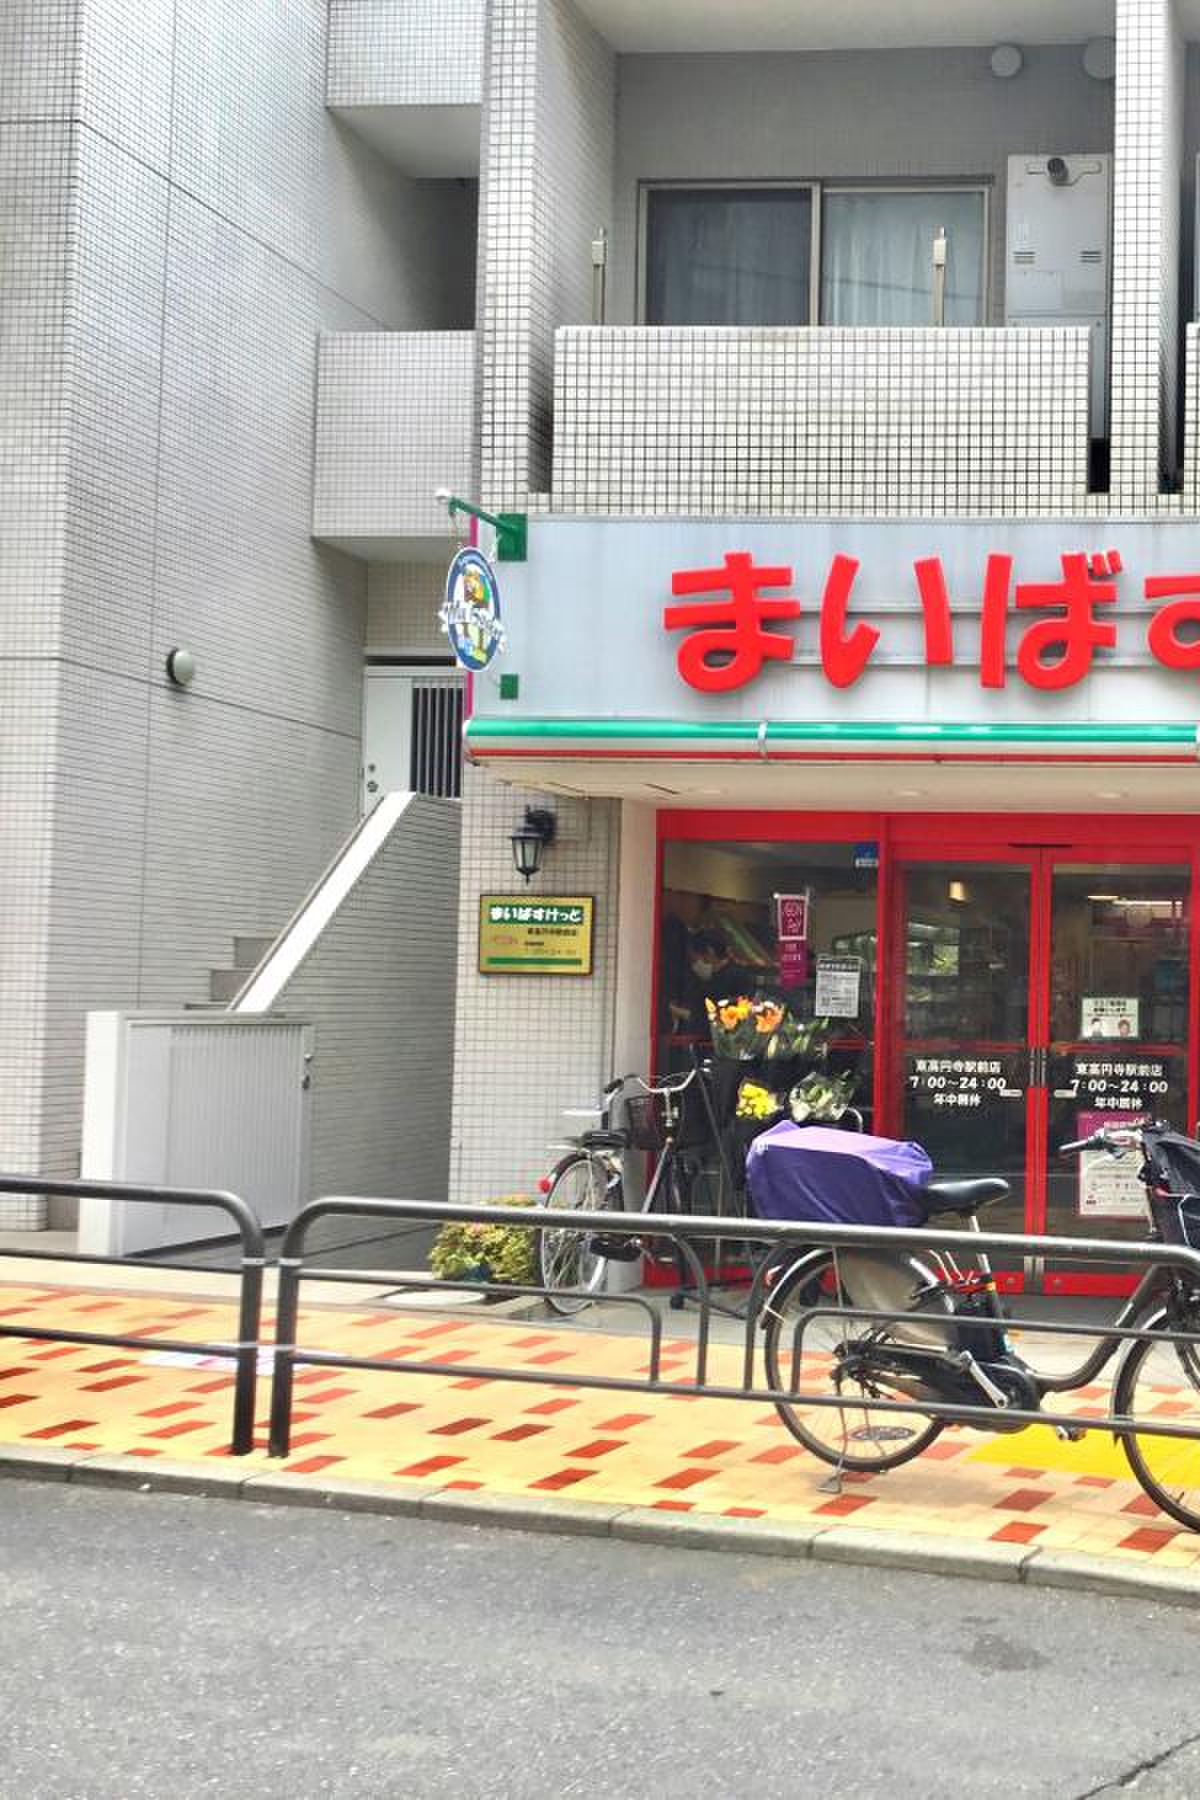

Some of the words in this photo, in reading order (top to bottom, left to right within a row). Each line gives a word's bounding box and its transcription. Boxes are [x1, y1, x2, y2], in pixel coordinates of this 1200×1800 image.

[490, 906, 582, 922] まいばすけっと
